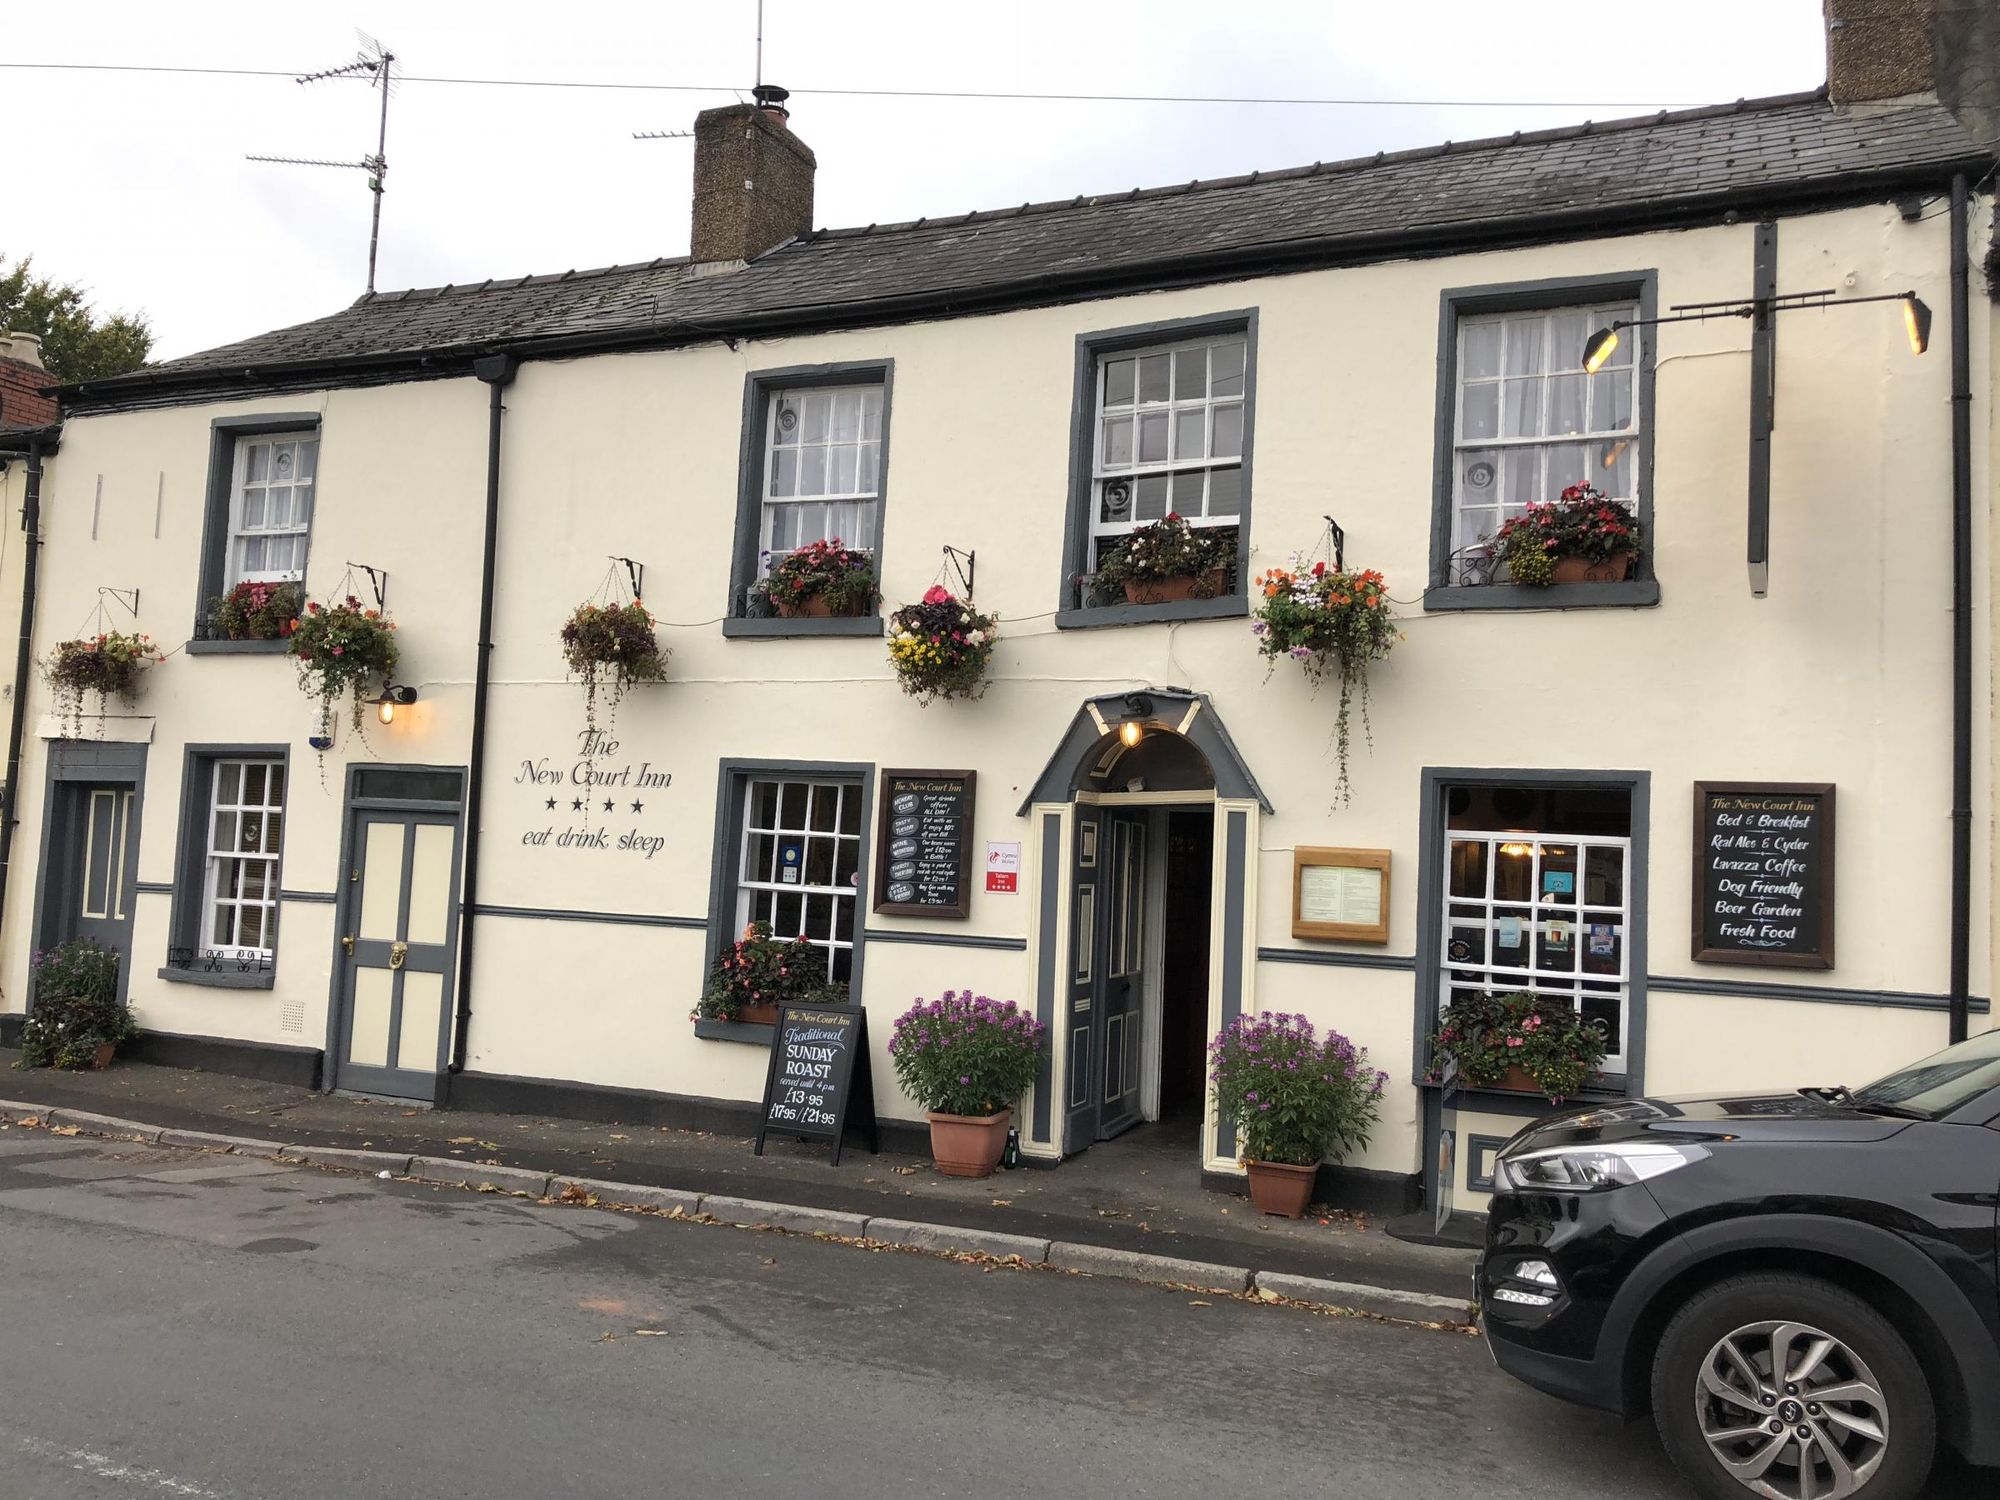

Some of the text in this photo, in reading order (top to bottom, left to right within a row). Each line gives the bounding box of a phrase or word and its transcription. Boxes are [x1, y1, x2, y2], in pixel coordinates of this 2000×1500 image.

[577, 729, 620, 756] The
[514, 758, 672, 788] New Court Inn
[895, 781, 962, 792] The New Court Inn
[898, 801, 914, 811] CLUB
[1711, 798, 1816, 811] The New Court Inn
[1716, 813, 1743, 826] Bed
[1757, 814, 1811, 830] Breakfast
[522, 827, 665, 859] eat drink sleep
[1711, 834, 1735, 850] Real
[1735, 835, 1757, 849] Ales
[1774, 836, 1810, 854] Cyder
[1712, 856, 1807, 878] Lavazza Coffee
[1718, 879, 1804, 900] Dog Friendly
[1714, 900, 1803, 917] Beer Garden
[1720, 922, 1797, 939] Fresh Food
[787, 1011, 851, 1026] The New Court Inn
[784, 1026, 845, 1046] Traditional
[786, 1044, 838, 1063] SUNDAY
[785, 1061, 832, 1079] ROAST
[780, 1078, 800, 1087] served
[799, 1079, 816, 1089] until
